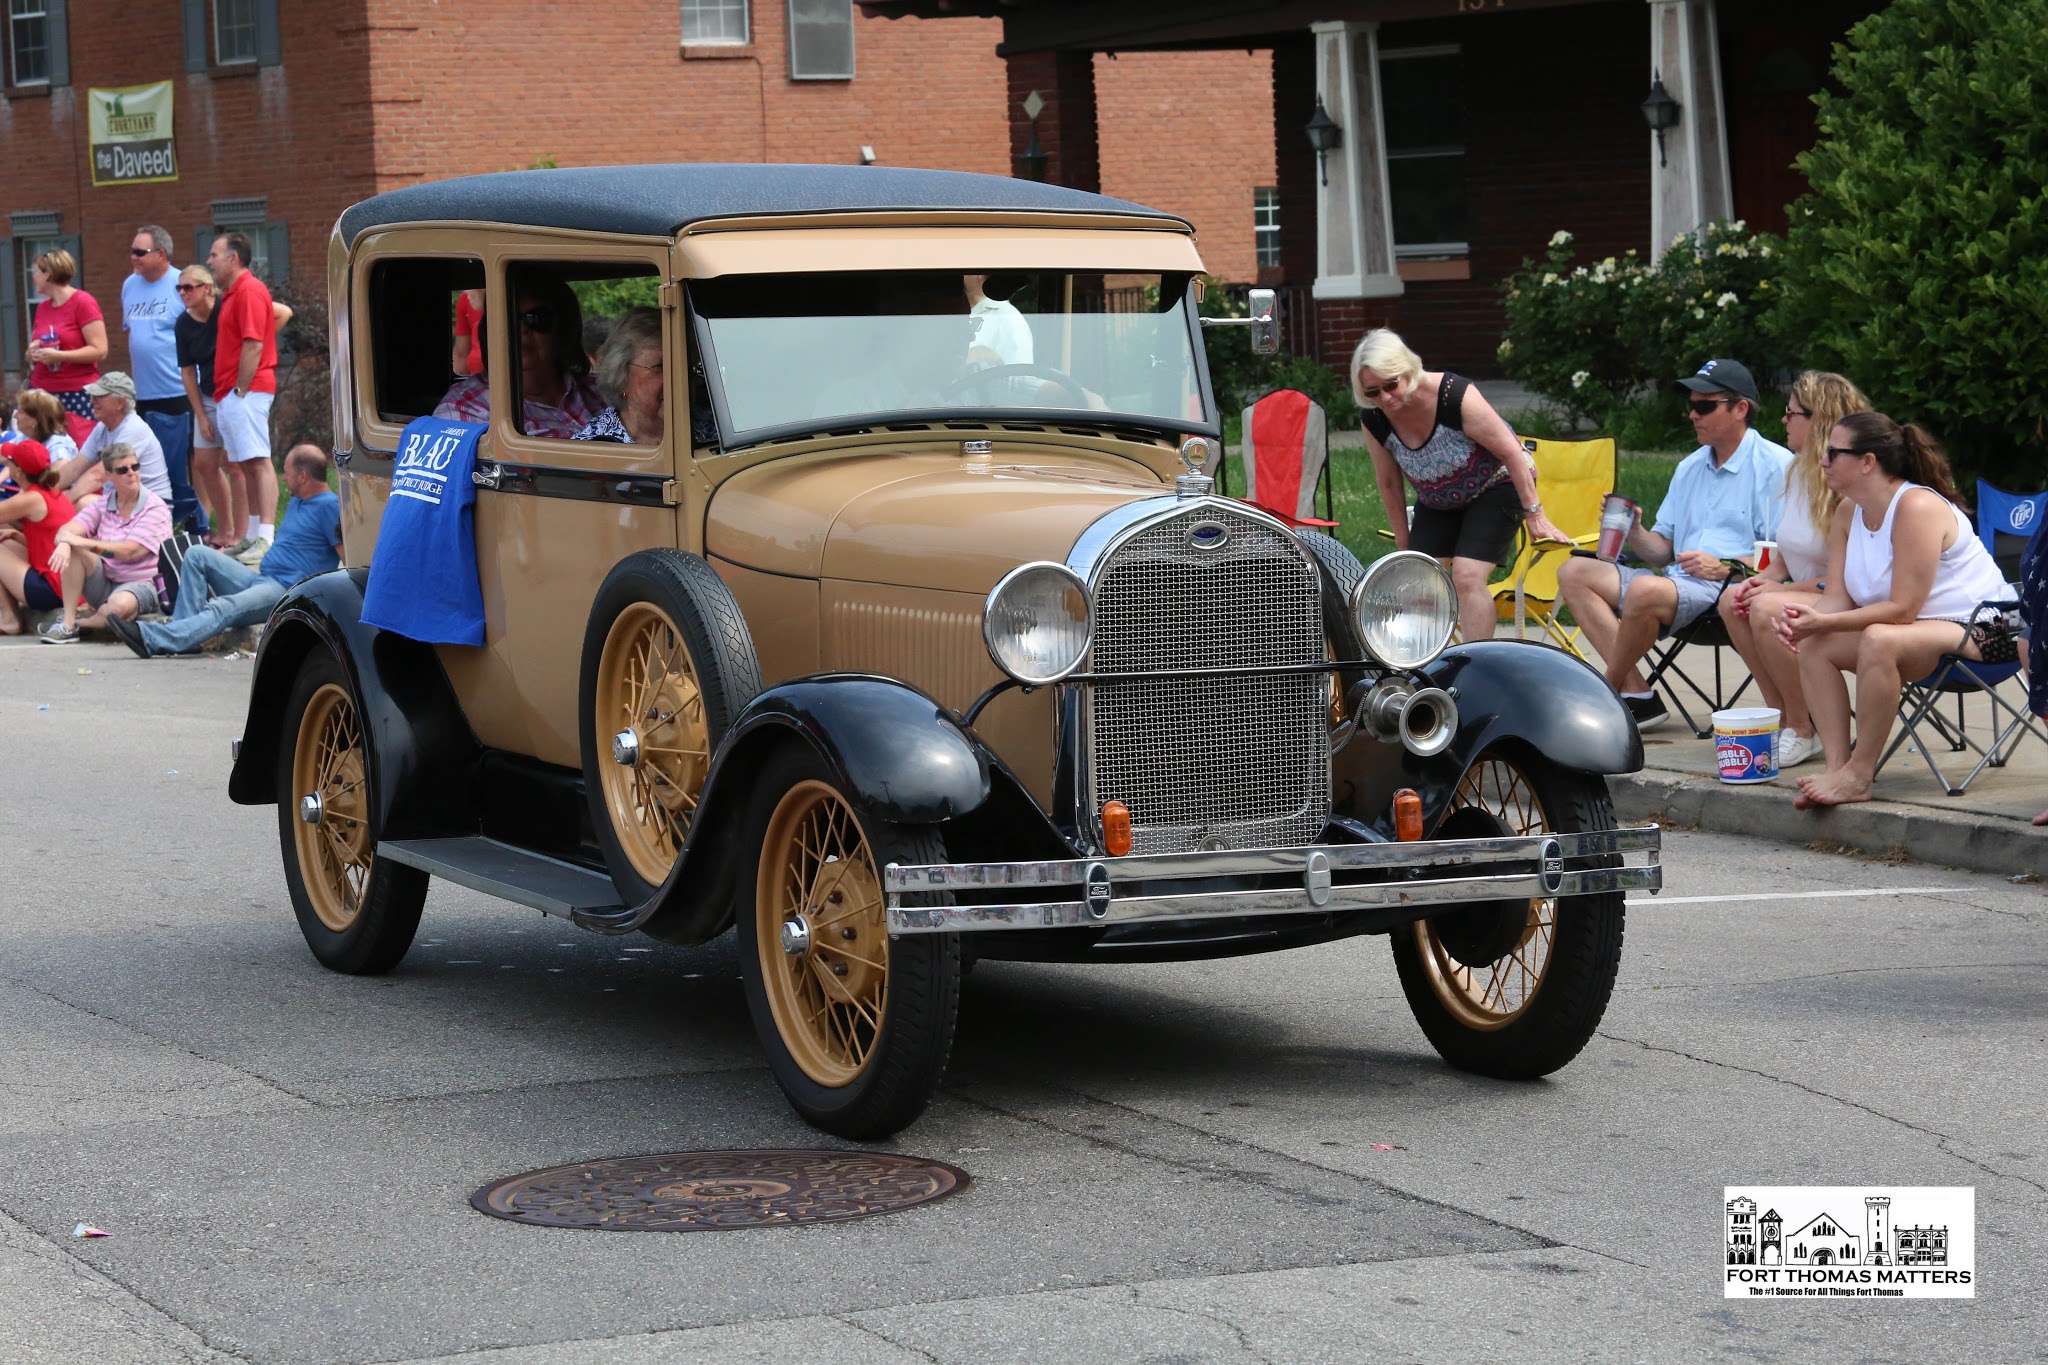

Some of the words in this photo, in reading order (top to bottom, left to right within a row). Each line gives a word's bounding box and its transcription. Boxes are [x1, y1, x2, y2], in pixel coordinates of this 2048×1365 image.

[96, 150, 112, 169] the
[113, 141, 173, 178] Daveed
[398, 434, 461, 471] BLAU
[416, 481, 444, 495] JUDGE
[1719, 757, 1749, 769] BUBBLE
